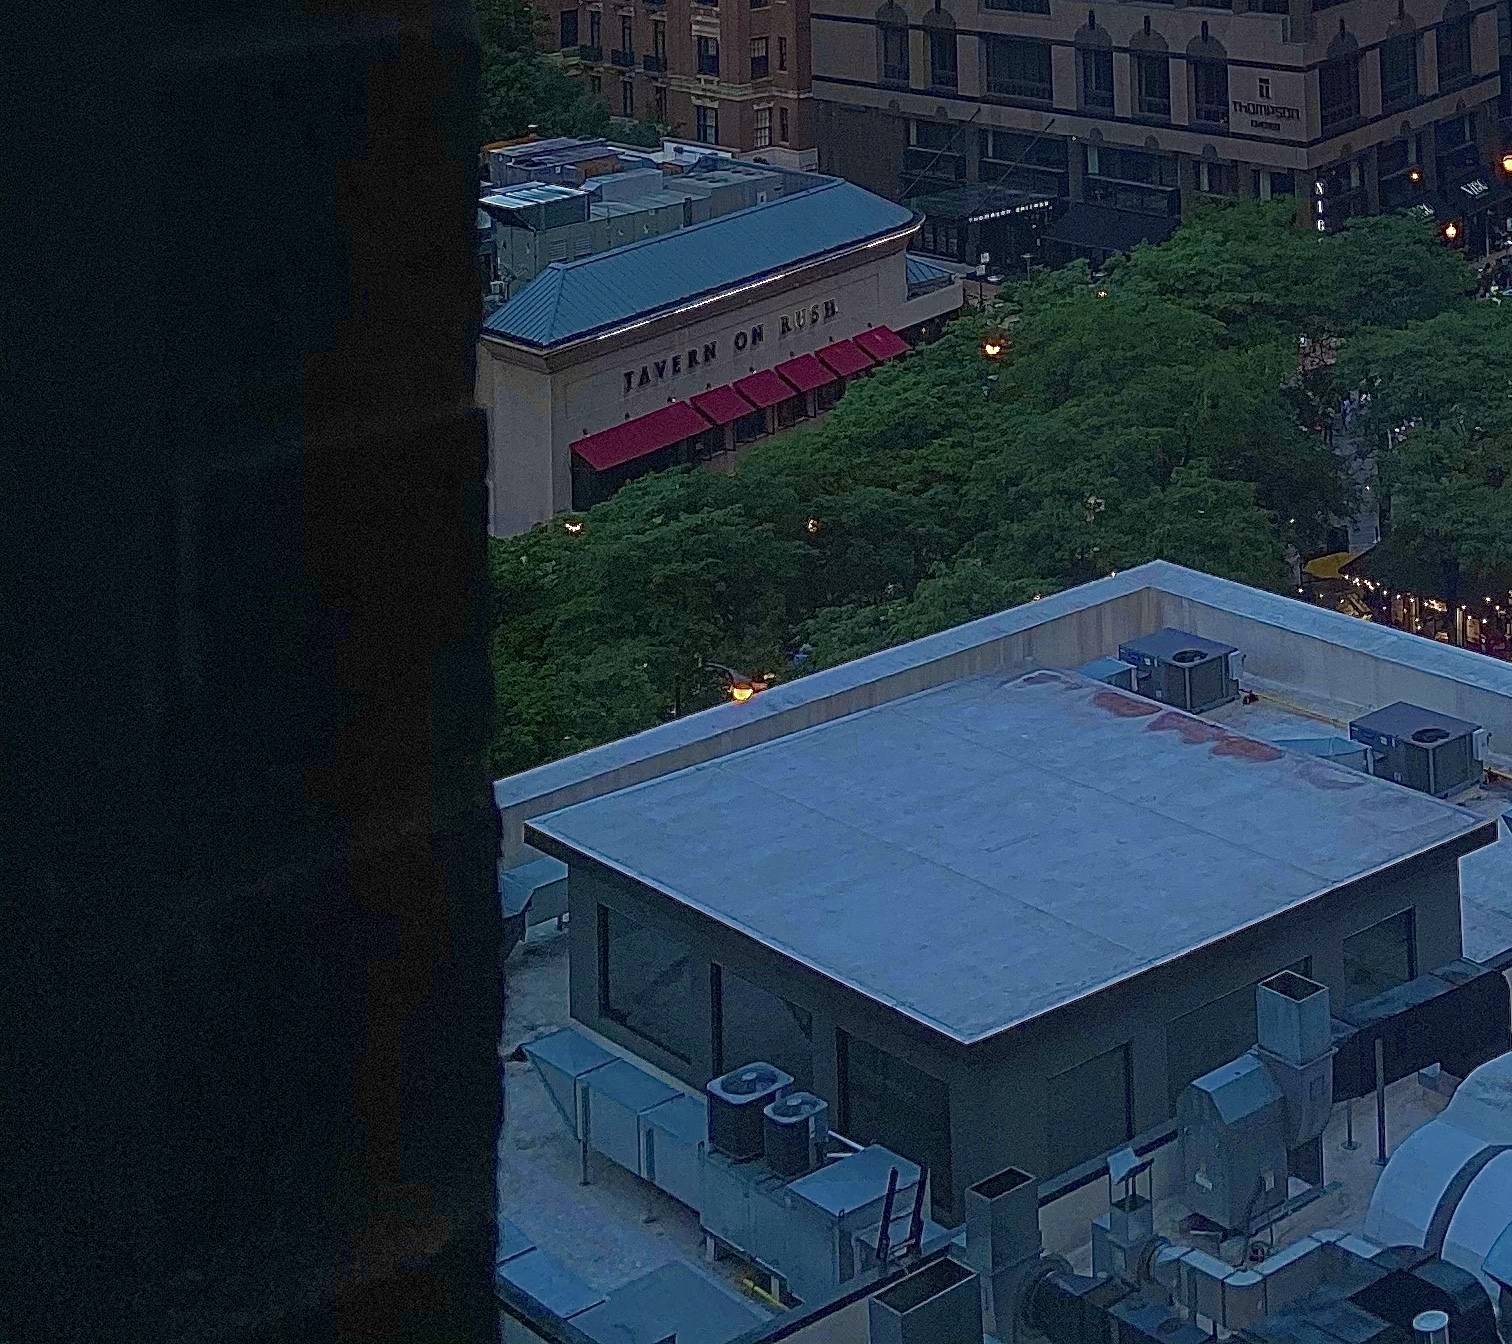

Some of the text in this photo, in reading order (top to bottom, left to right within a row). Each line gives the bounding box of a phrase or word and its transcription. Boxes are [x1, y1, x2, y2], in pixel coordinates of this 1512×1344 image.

[623, 299, 839, 393] TAVERN ON RUSH
